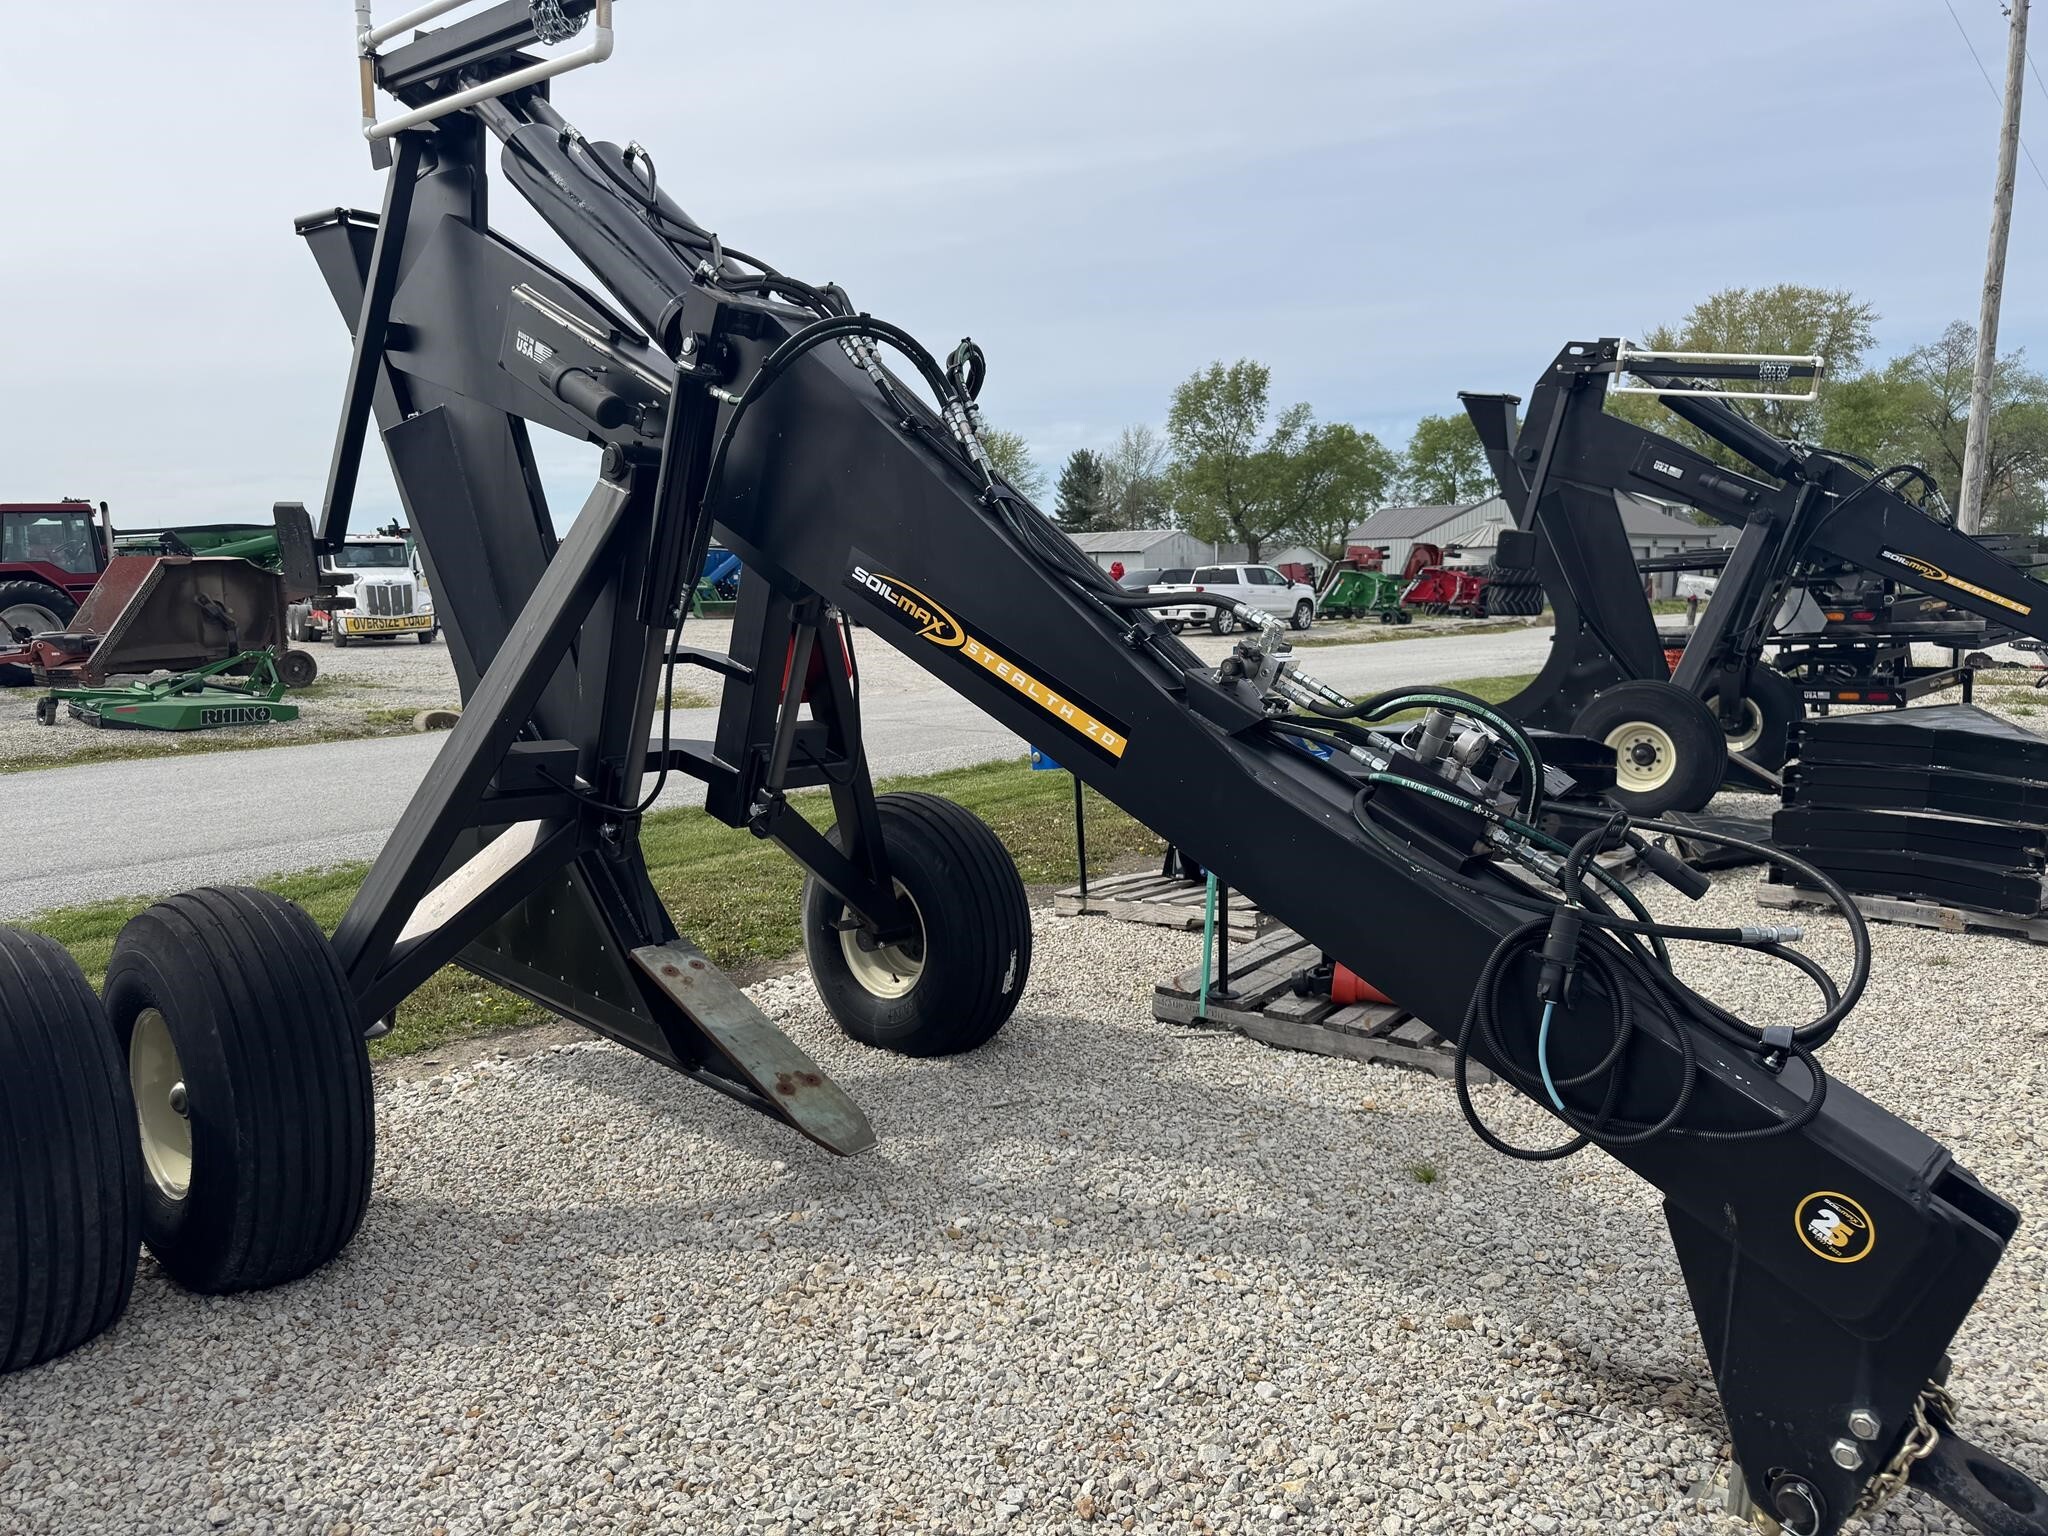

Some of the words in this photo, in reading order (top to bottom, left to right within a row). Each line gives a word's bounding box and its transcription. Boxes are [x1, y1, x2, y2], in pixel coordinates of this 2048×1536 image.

[516, 337, 534, 359] USA
[1881, 550, 1938, 577] SOIL-MAX
[851, 566, 949, 636] SOIL-MAX
[353, 617, 400, 630] OVERSIZE
[403, 616, 426, 627] LOAD
[967, 642, 1076, 719] STEALTH
[200, 706, 272, 726] RHINO
[1431, 790, 1470, 808] AEROQUIP
[1808, 1223, 1835, 1246] YEARS
[1810, 1208, 1855, 1247] 25
